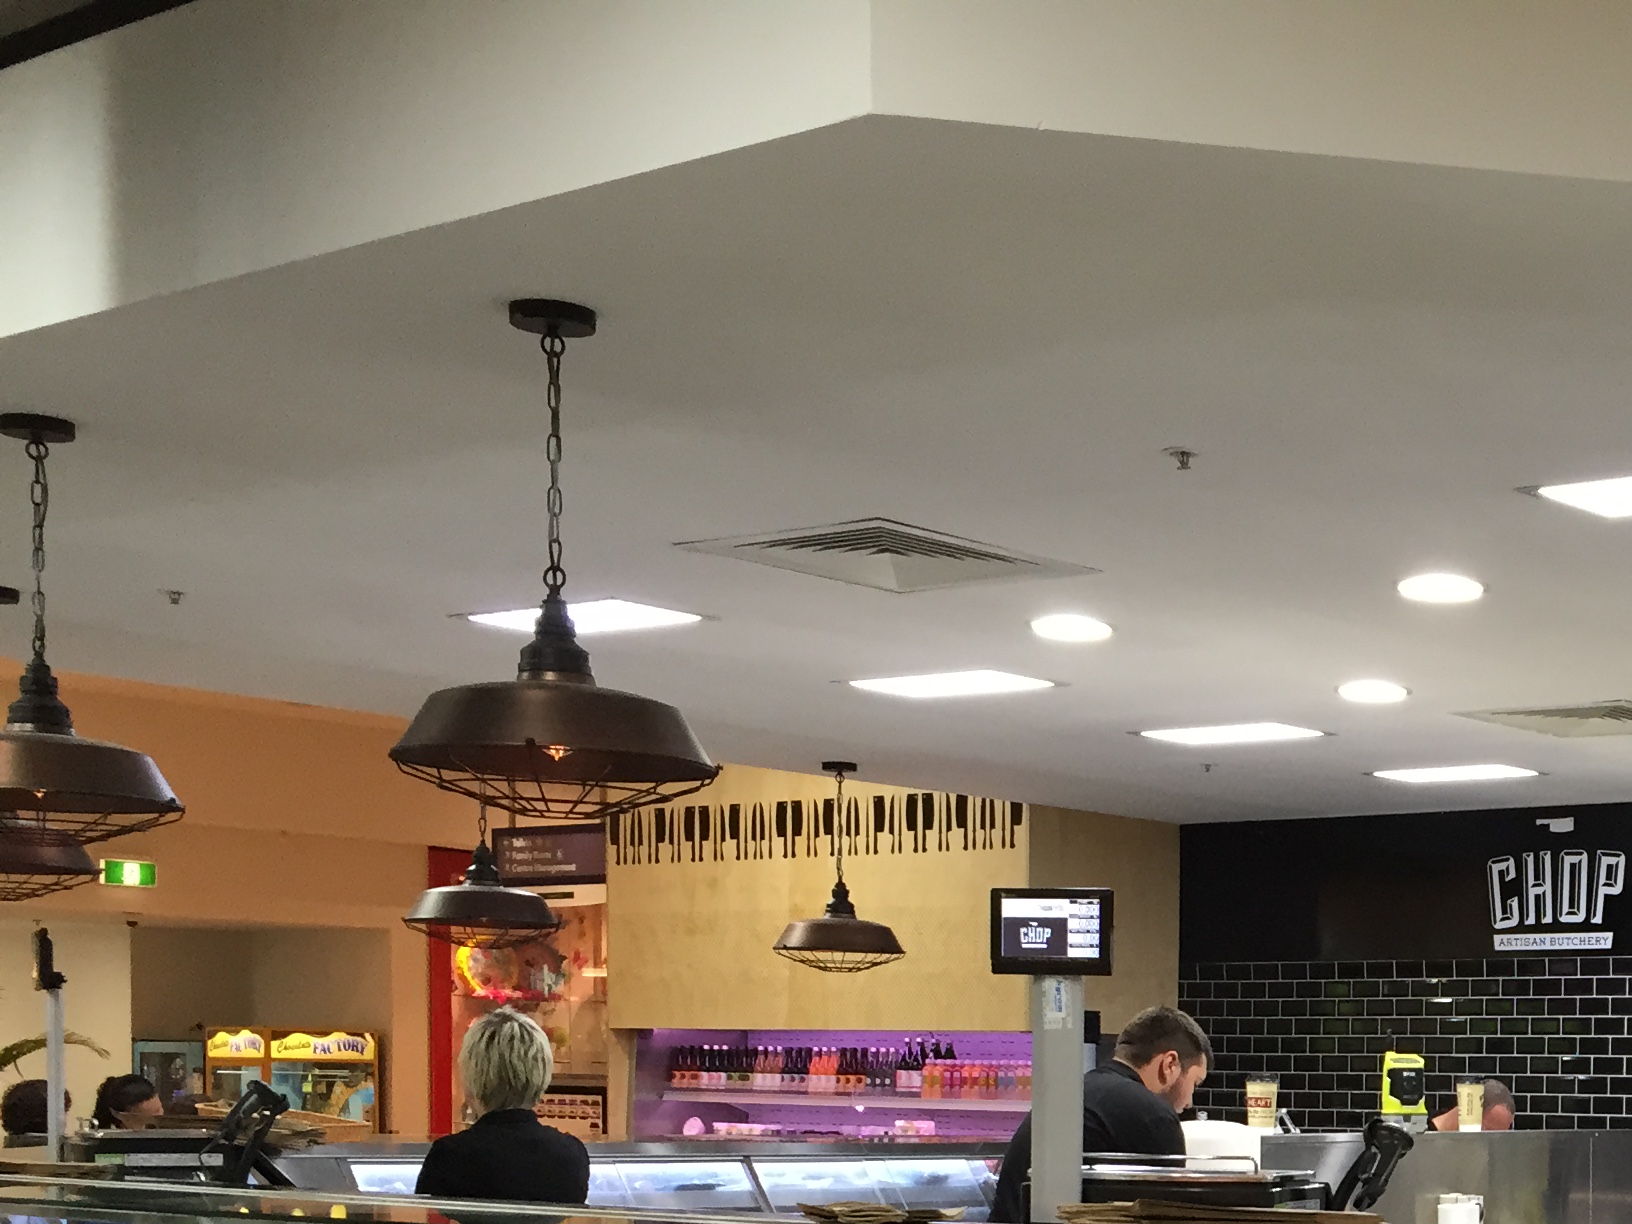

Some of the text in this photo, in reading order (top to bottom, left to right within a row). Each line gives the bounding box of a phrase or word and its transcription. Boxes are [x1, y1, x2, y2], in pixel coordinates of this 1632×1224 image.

[1487, 849, 1626, 929] CHOP
[1020, 926, 1052, 943] CHOP
[1499, 936, 1610, 947] ARTISAN BUTCHERY
[312, 1037, 369, 1056] FACTORY
